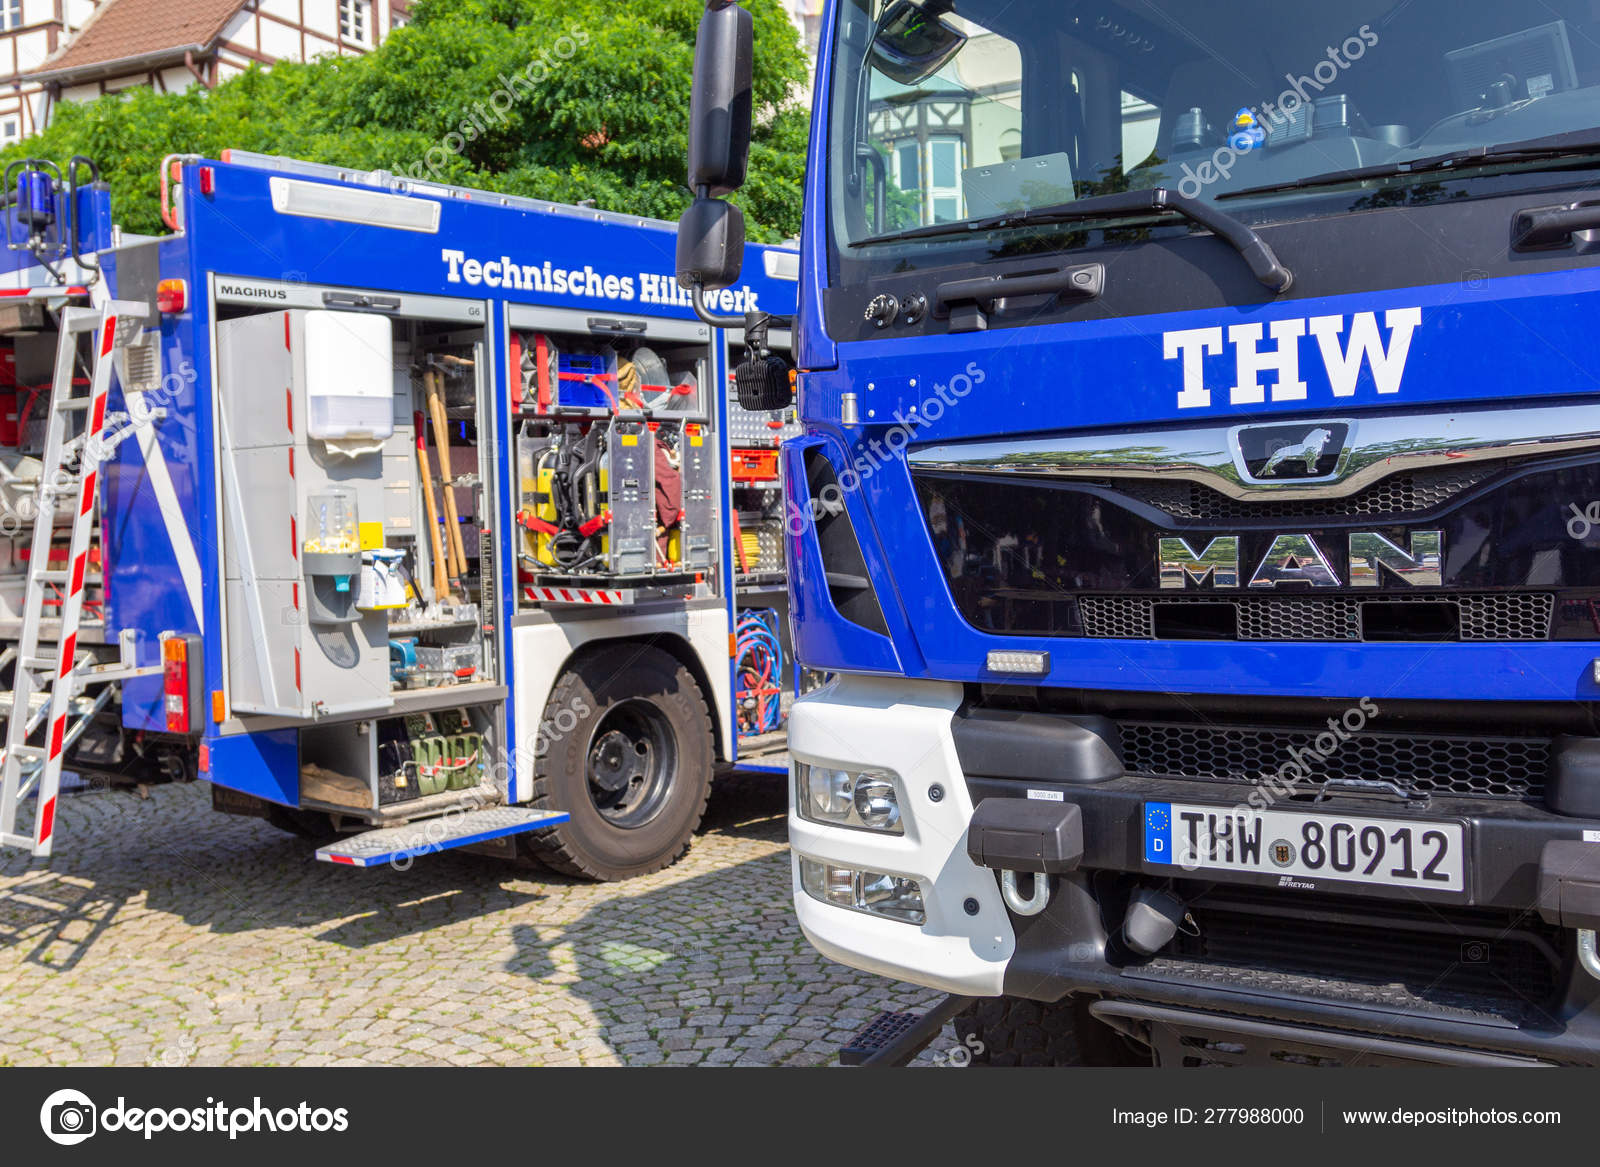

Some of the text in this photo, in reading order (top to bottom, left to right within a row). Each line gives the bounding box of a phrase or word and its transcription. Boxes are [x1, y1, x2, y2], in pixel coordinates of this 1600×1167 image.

[221, 285, 287, 300] MAGIRUS
[442, 249, 759, 312] Technisches Hilfwerk
[468, 307, 481, 317] G6
[1163, 306, 1422, 409] THW
[1158, 531, 1444, 589] MAN
[1153, 838, 1164, 852] D
[1180, 811, 1263, 865] THW
[1301, 821, 1450, 882] 80912
